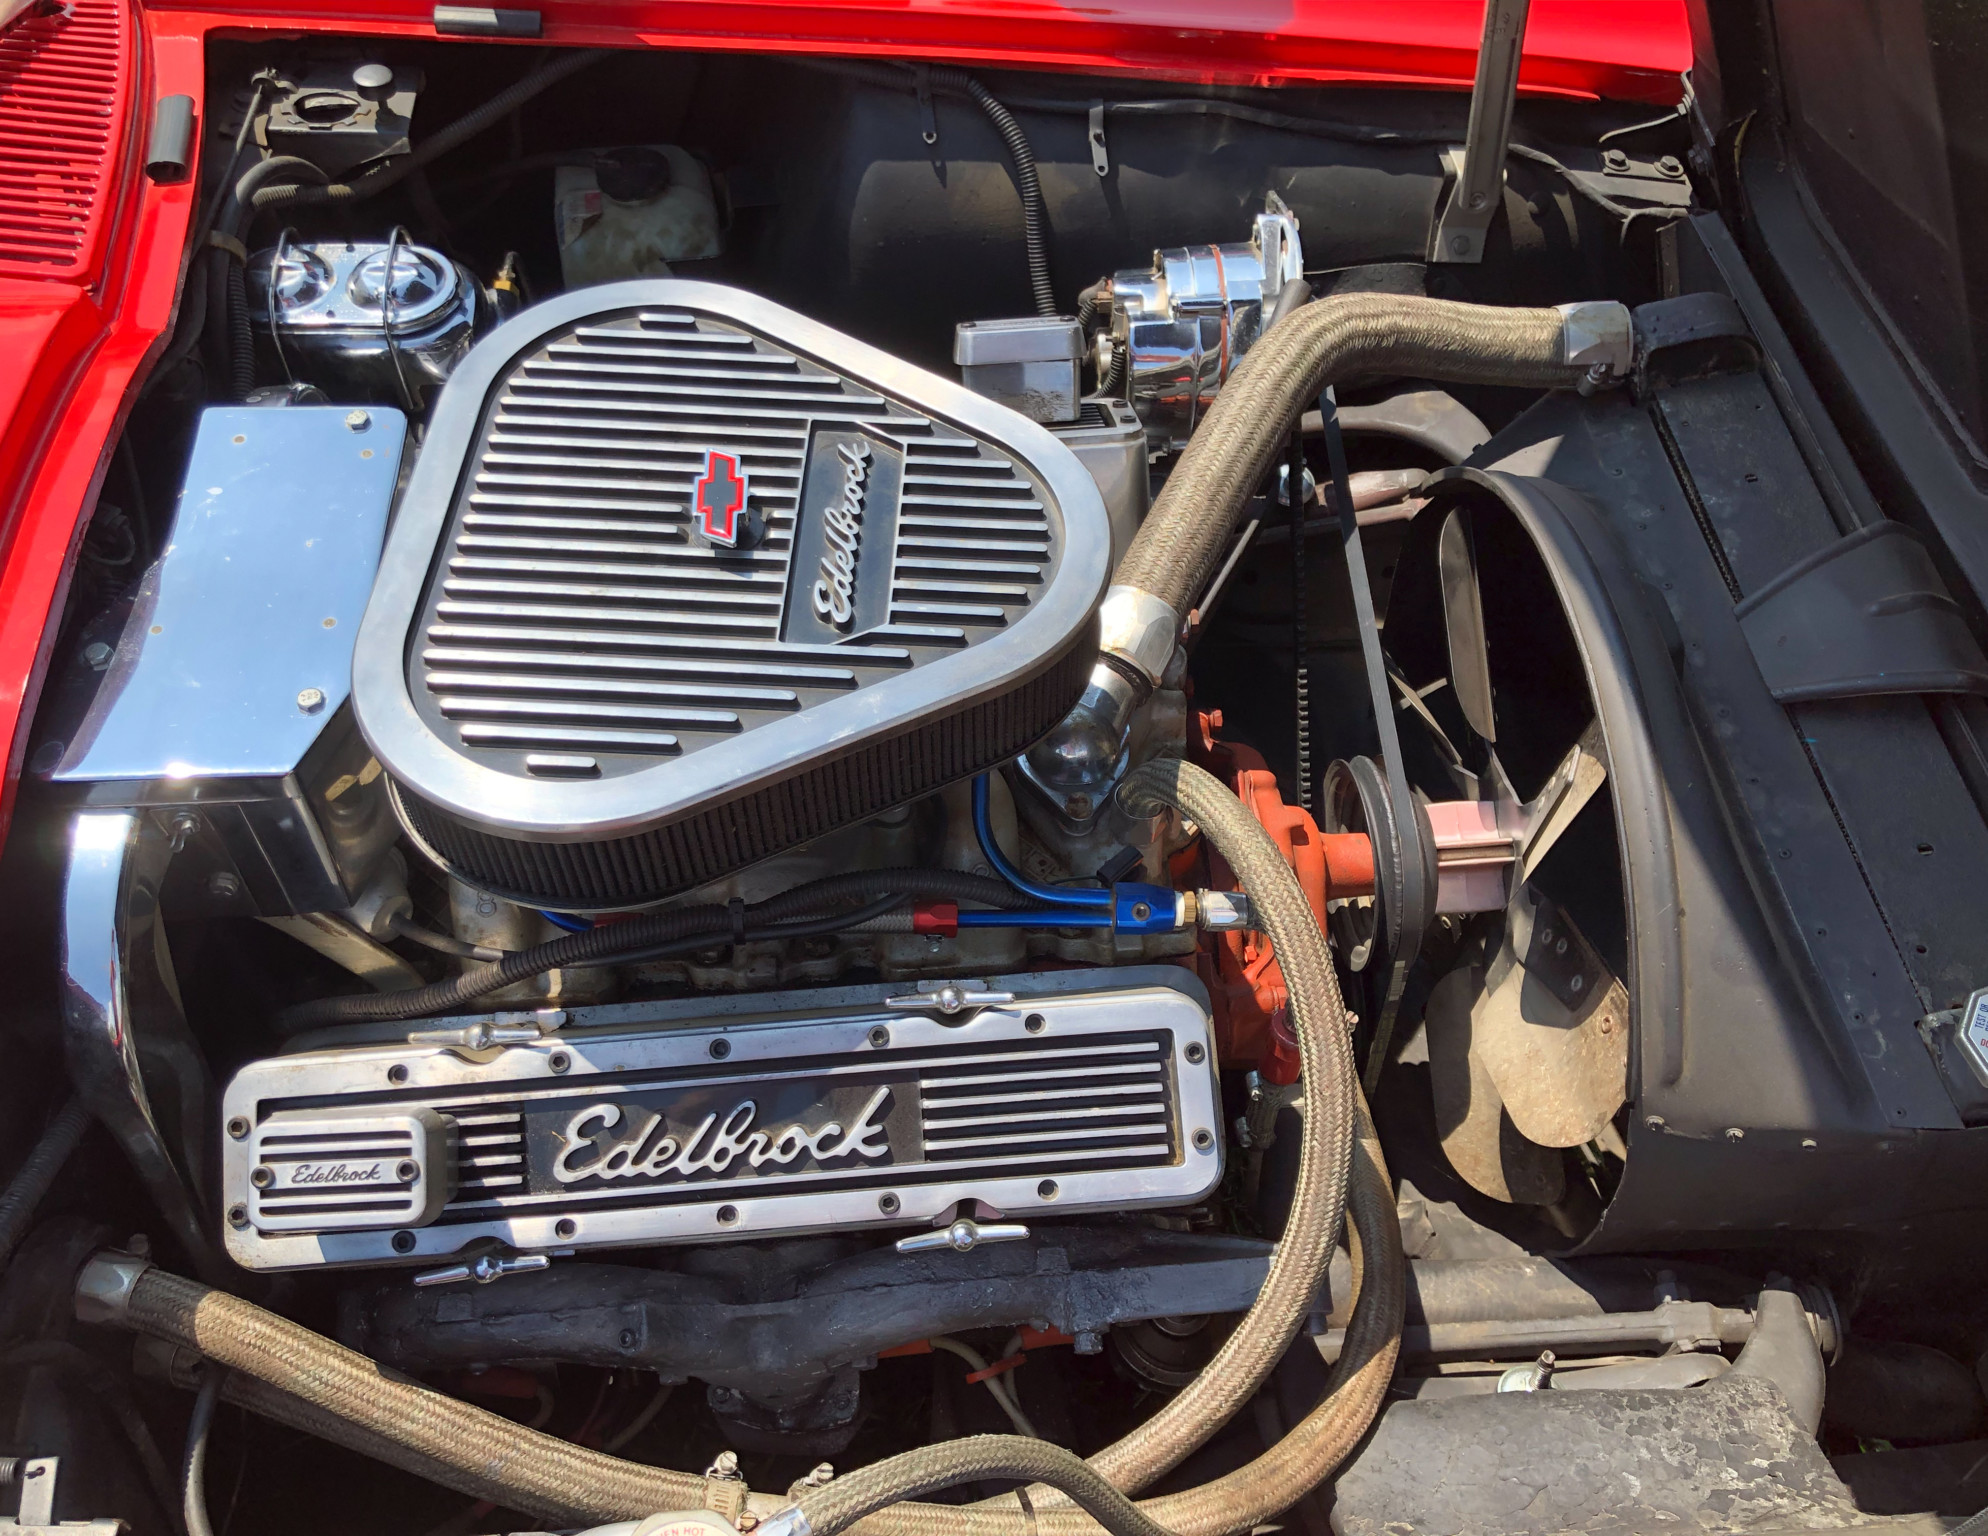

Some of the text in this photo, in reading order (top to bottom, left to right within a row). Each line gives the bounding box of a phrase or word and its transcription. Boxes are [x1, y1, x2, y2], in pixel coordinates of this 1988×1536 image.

[813, 441, 872, 624] Edelbrock
[1974, 1013, 1987, 1029] TEST
[552, 1086, 891, 1183] Edelbrock
[291, 1163, 382, 1185] Edelbrock
